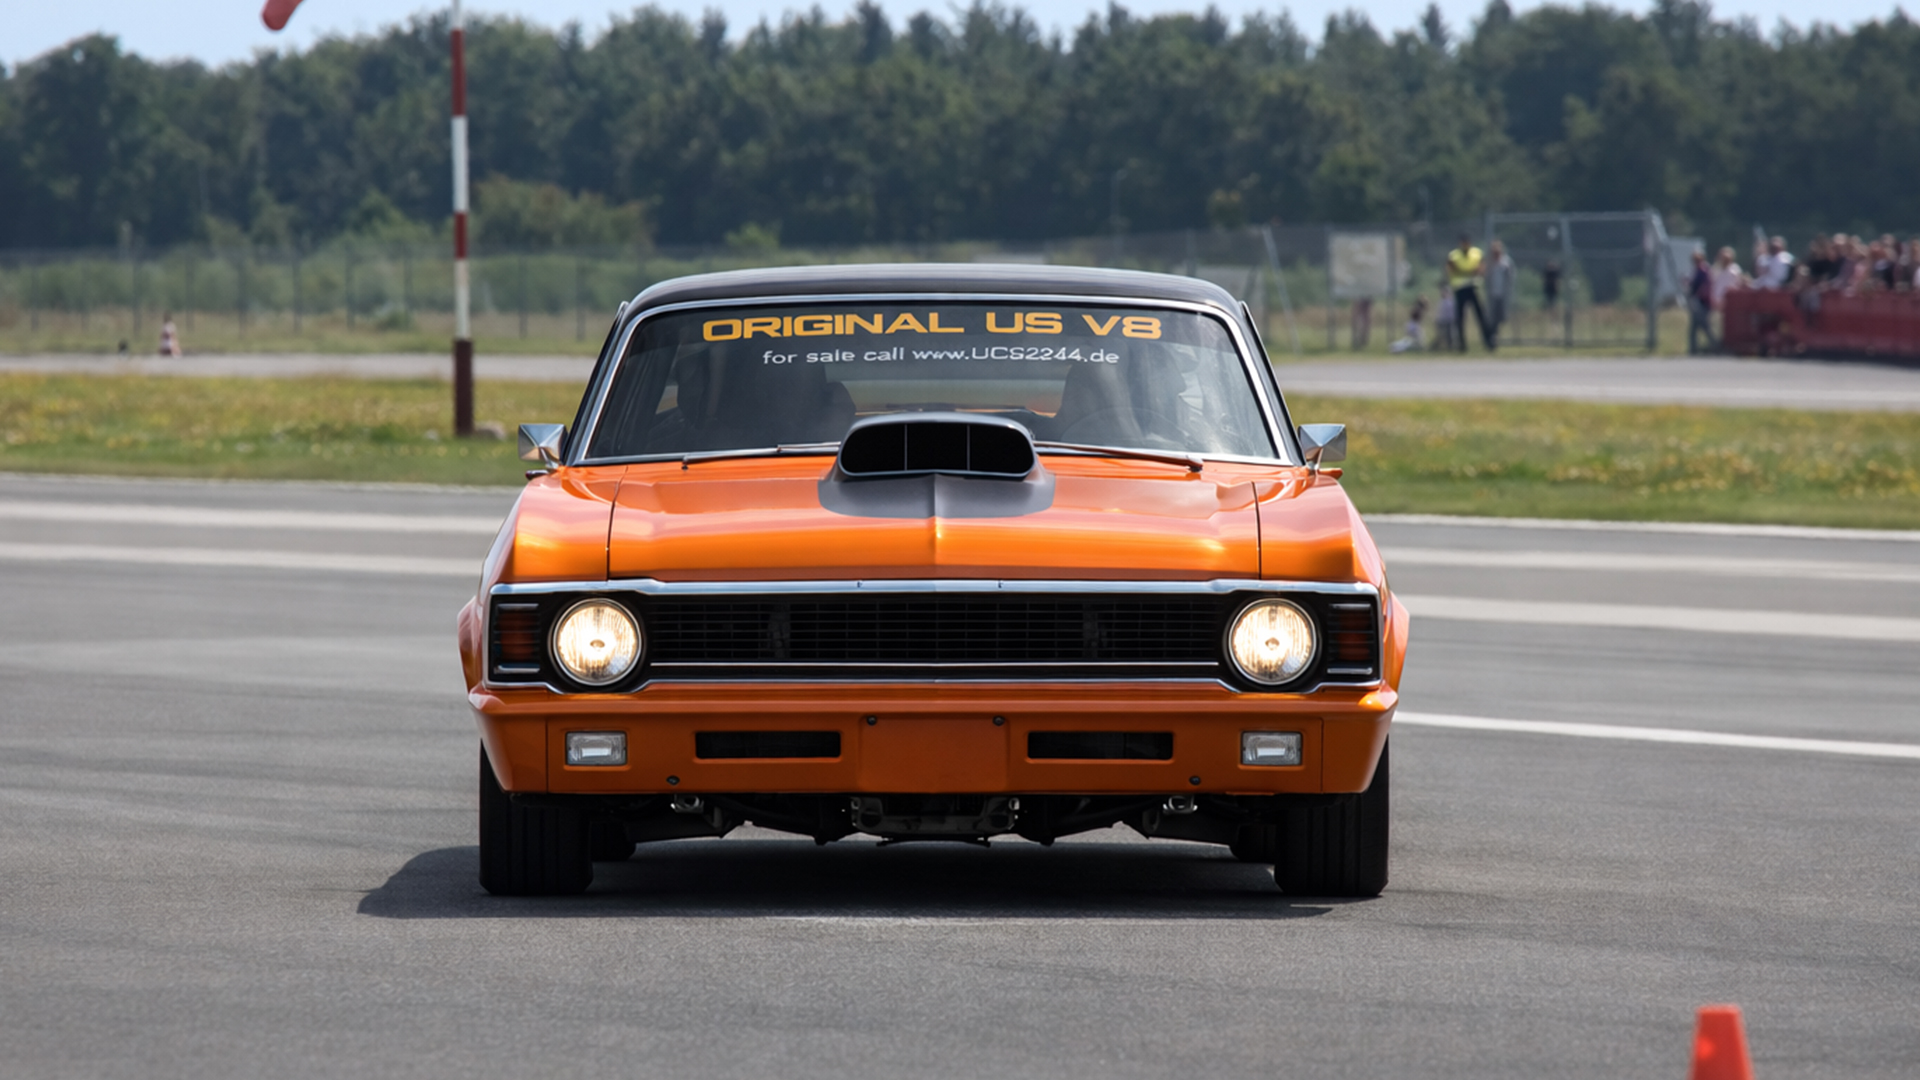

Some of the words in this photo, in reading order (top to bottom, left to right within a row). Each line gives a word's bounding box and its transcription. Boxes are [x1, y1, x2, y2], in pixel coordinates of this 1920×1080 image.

[702, 312, 965, 341] ORIGINAL
[986, 312, 1063, 334] US
[1082, 315, 1162, 340] V8
[762, 350, 798, 365] for
[806, 349, 856, 363] sale
[863, 347, 905, 362] call
